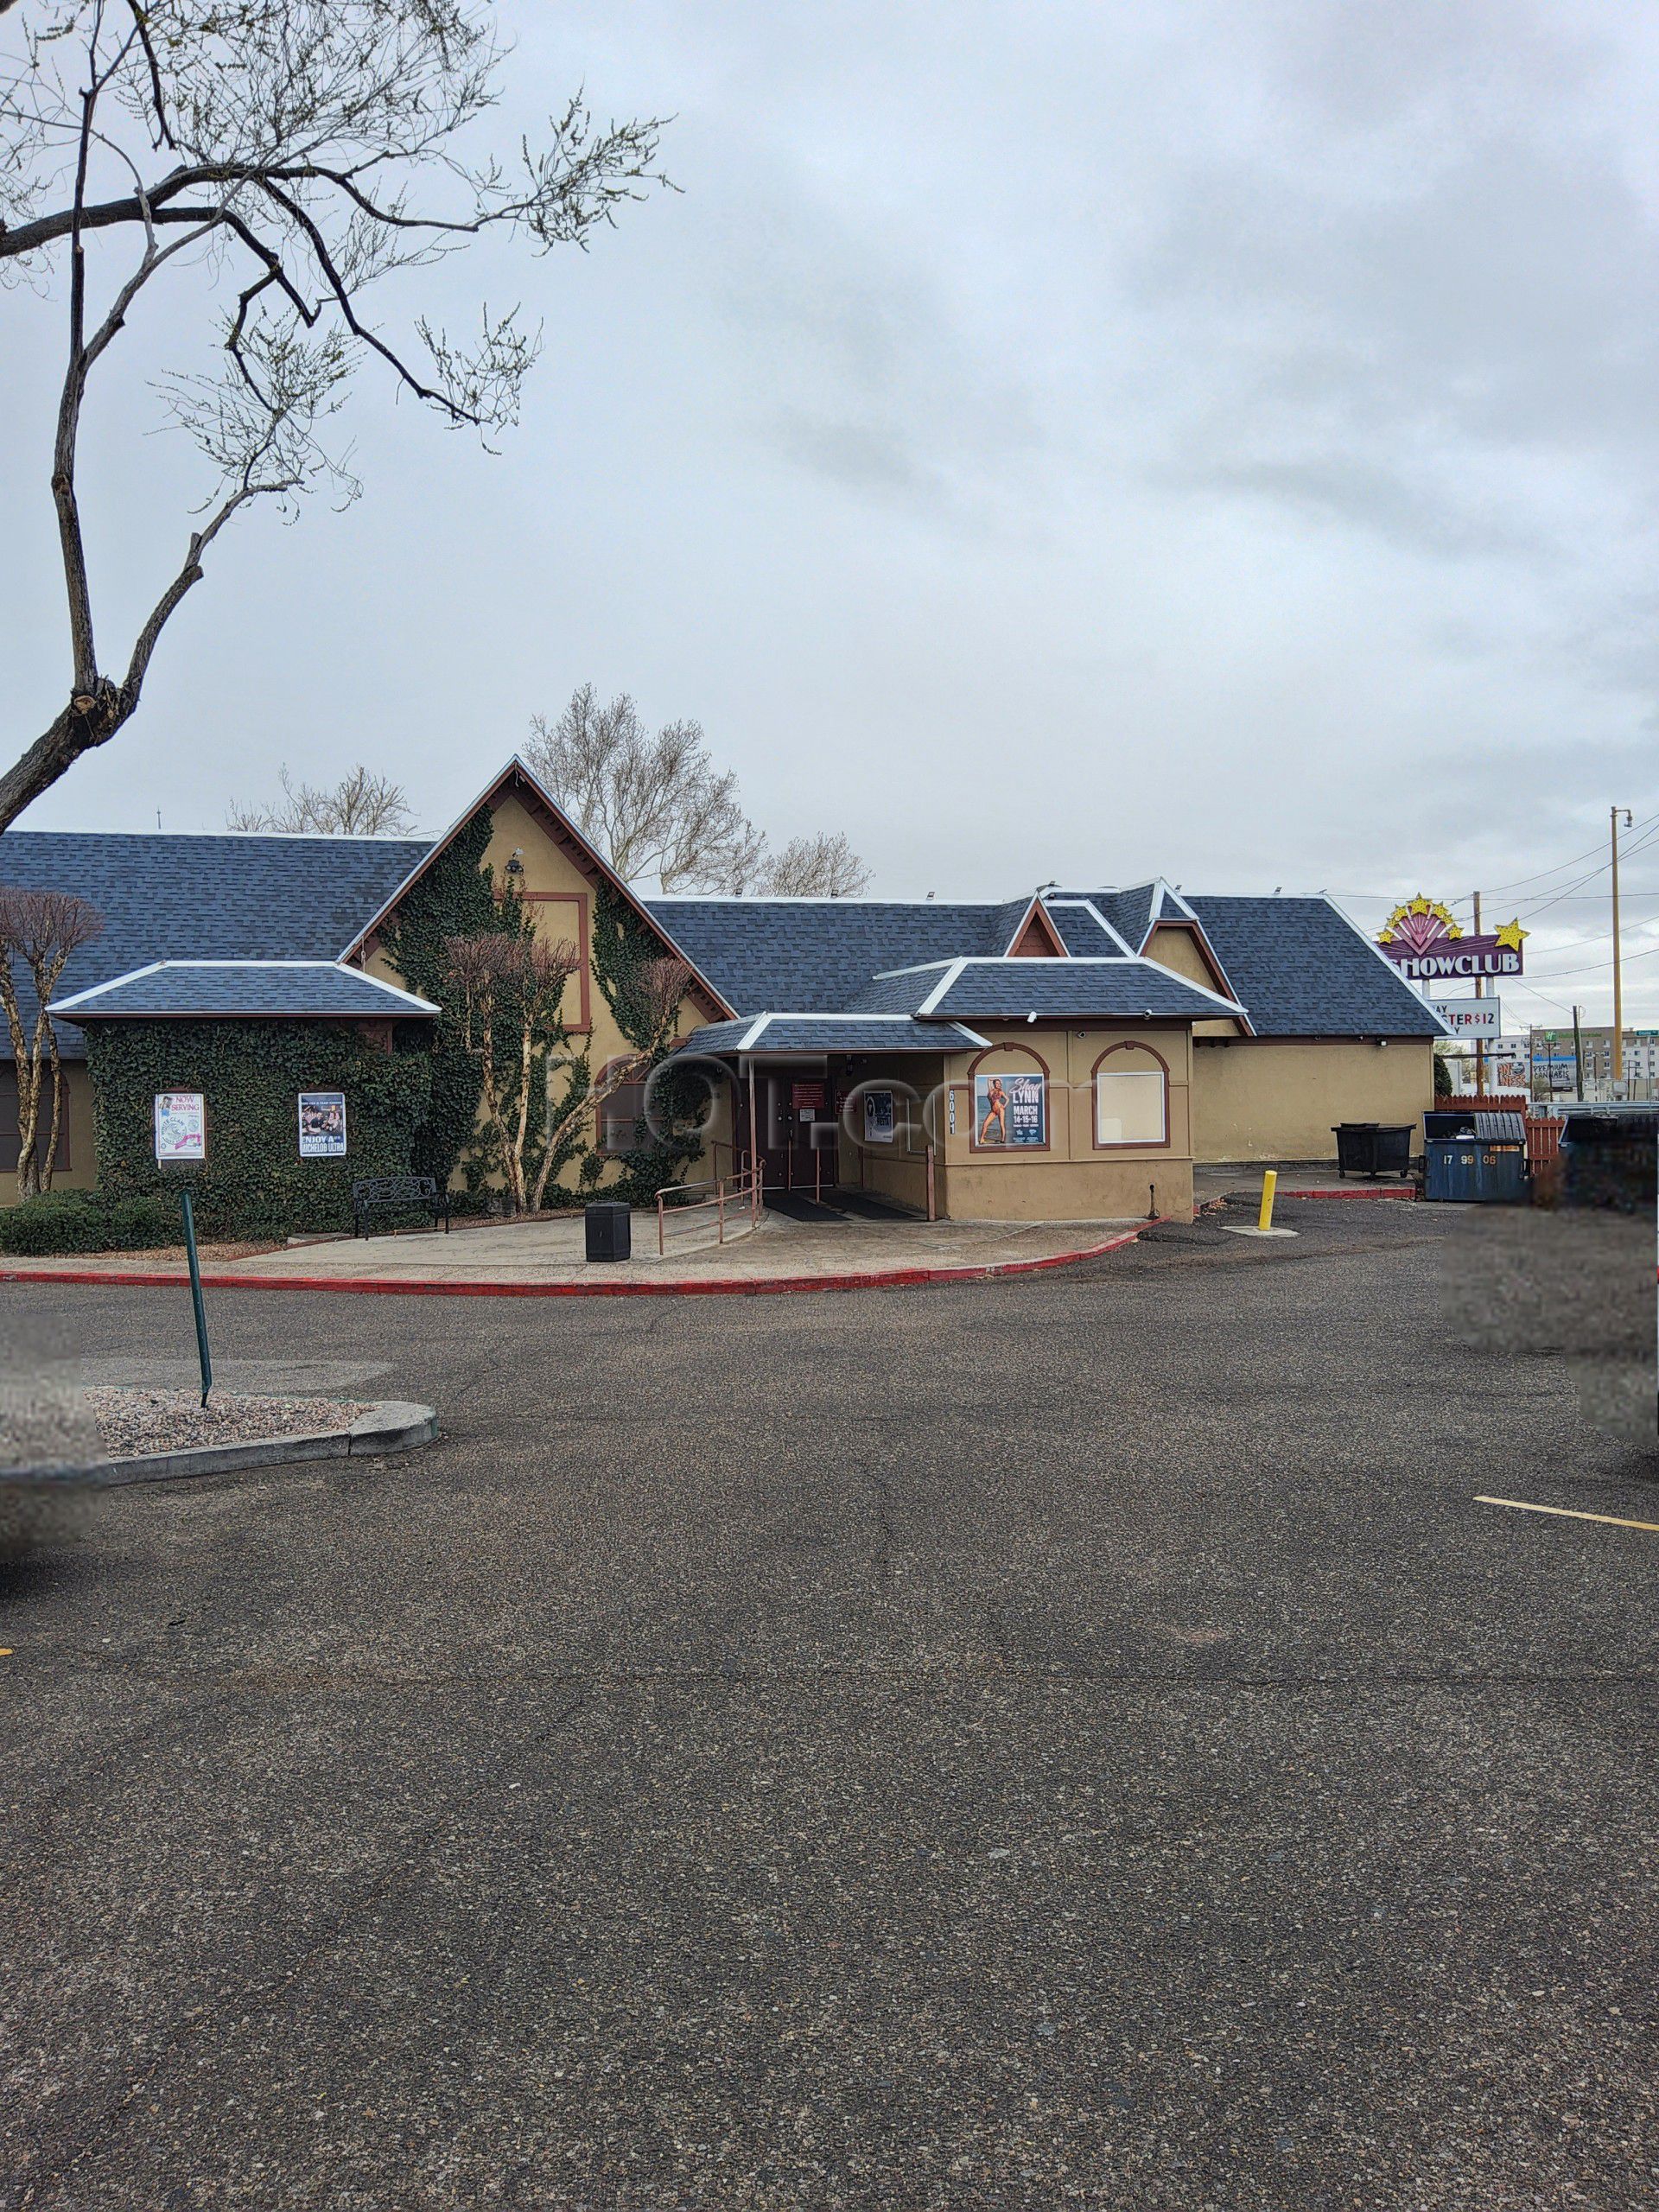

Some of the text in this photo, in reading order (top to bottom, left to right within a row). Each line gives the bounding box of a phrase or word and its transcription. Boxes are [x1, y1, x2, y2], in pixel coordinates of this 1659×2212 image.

[1534, 1063, 1568, 1072] PREMIUM
[1534, 1071, 1570, 1080] CANNABIS
[1009, 1077, 1042, 1094] Shay
[1012, 1090, 1039, 1104] LYNN
[1013, 1105, 1038, 1116] MARCH
[327, 1142, 344, 1152] ULTRA
[1443, 1154, 1497, 1165] 17 99 06
